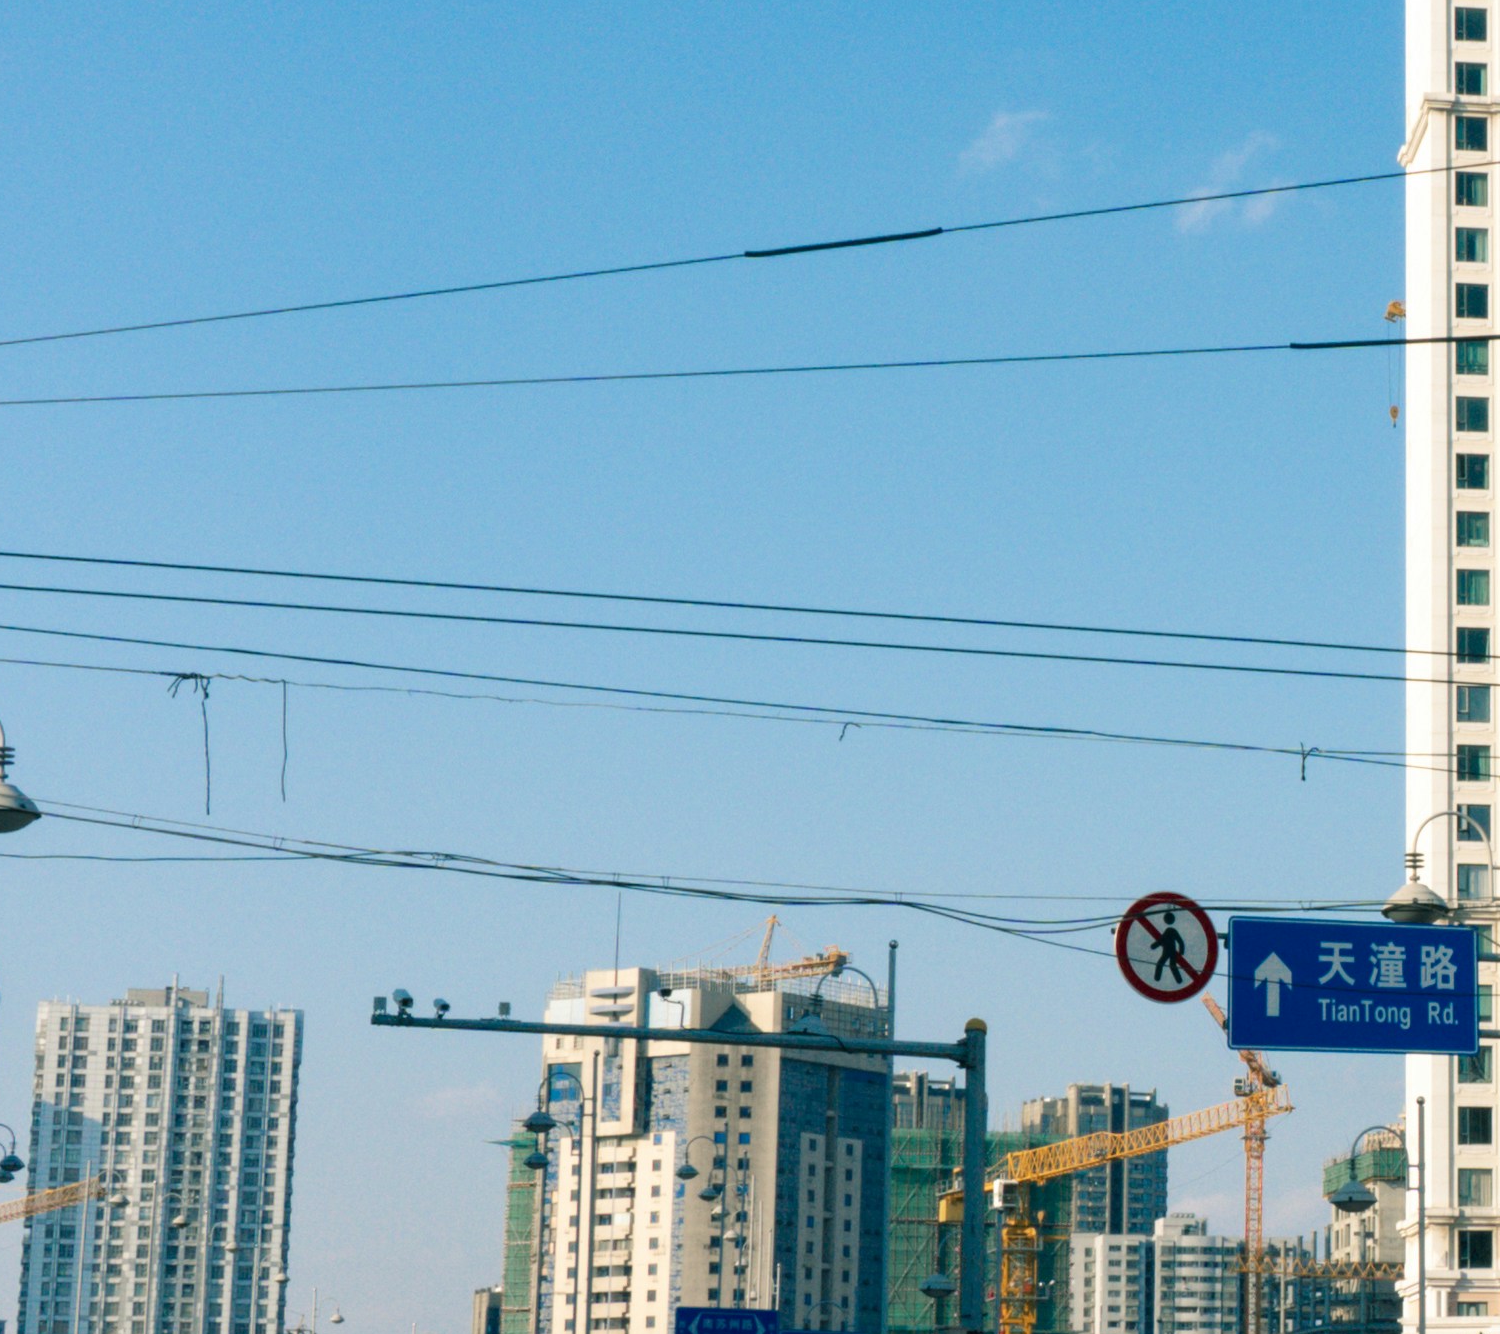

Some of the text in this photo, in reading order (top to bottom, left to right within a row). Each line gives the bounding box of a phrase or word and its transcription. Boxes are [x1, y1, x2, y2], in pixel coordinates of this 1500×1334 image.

[1318, 941, 1457, 990] 天潼路
[1318, 998, 1458, 1029] TianTong Rd.
